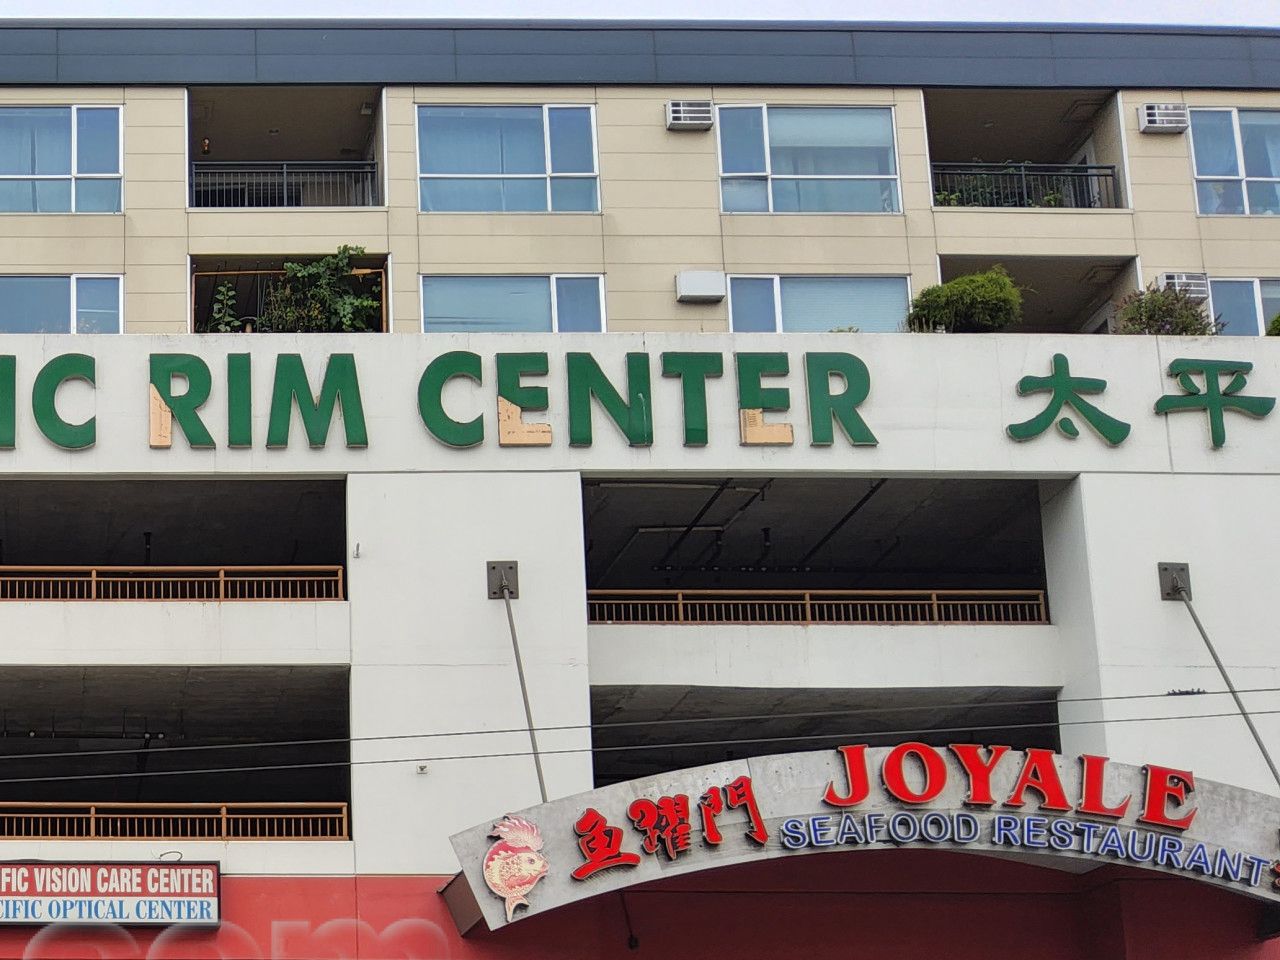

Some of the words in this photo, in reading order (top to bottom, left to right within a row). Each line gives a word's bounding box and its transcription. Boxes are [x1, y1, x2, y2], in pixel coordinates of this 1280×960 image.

[149, 353, 369, 450] RIM
[417, 350, 880, 448] CENTER
[1005, 353, 1277, 449] 太平
[823, 741, 1199, 831] JOYALE
[34, 867, 92, 893] VISION
[97, 868, 143, 894] CARE
[148, 868, 214, 894] CENTER
[779, 812, 981, 850] SEAFOOD
[997, 814, 1271, 888] RESTAURANT
[49, 899, 129, 920] OPTICAL
[136, 899, 213, 920] CENTER
